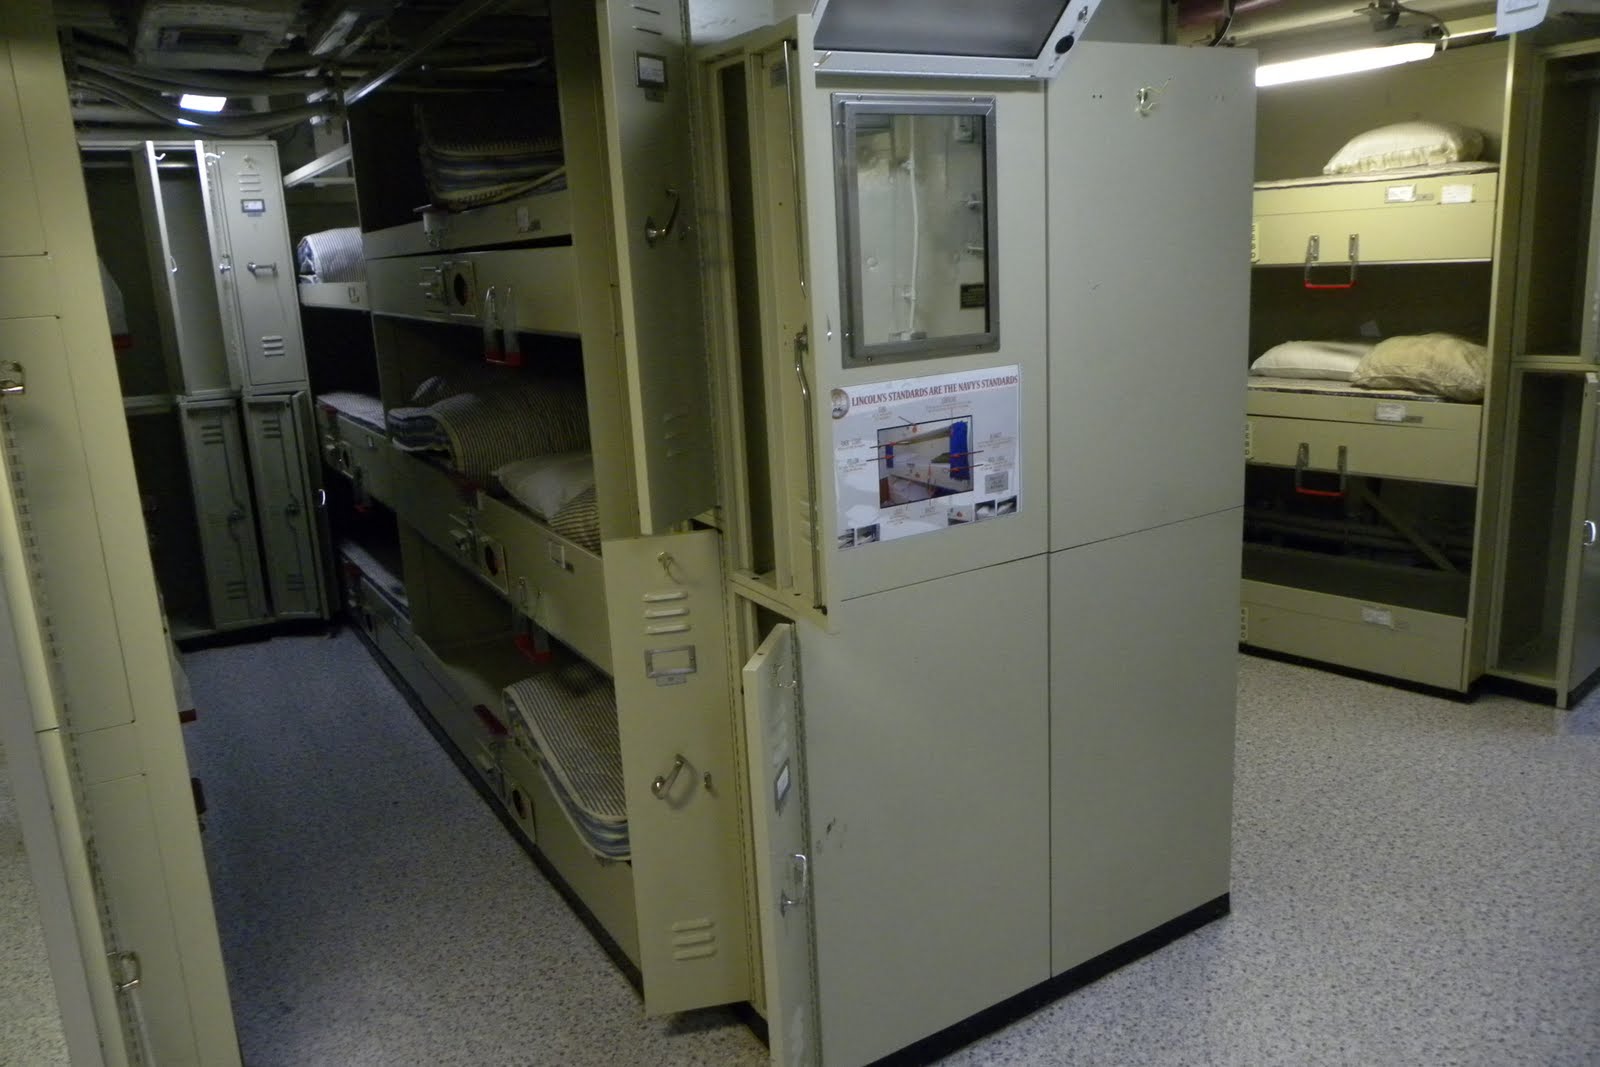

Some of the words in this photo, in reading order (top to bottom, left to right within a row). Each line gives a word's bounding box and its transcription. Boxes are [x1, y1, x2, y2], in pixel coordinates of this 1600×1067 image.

[852, 393, 887, 407] LINCOLN'S
[888, 387, 928, 402] STANDARDS
[929, 384, 942, 396] ARE
[943, 382, 957, 394] THE
[958, 379, 981, 392] NAVY'S
[981, 375, 1018, 389] STANDARDS
